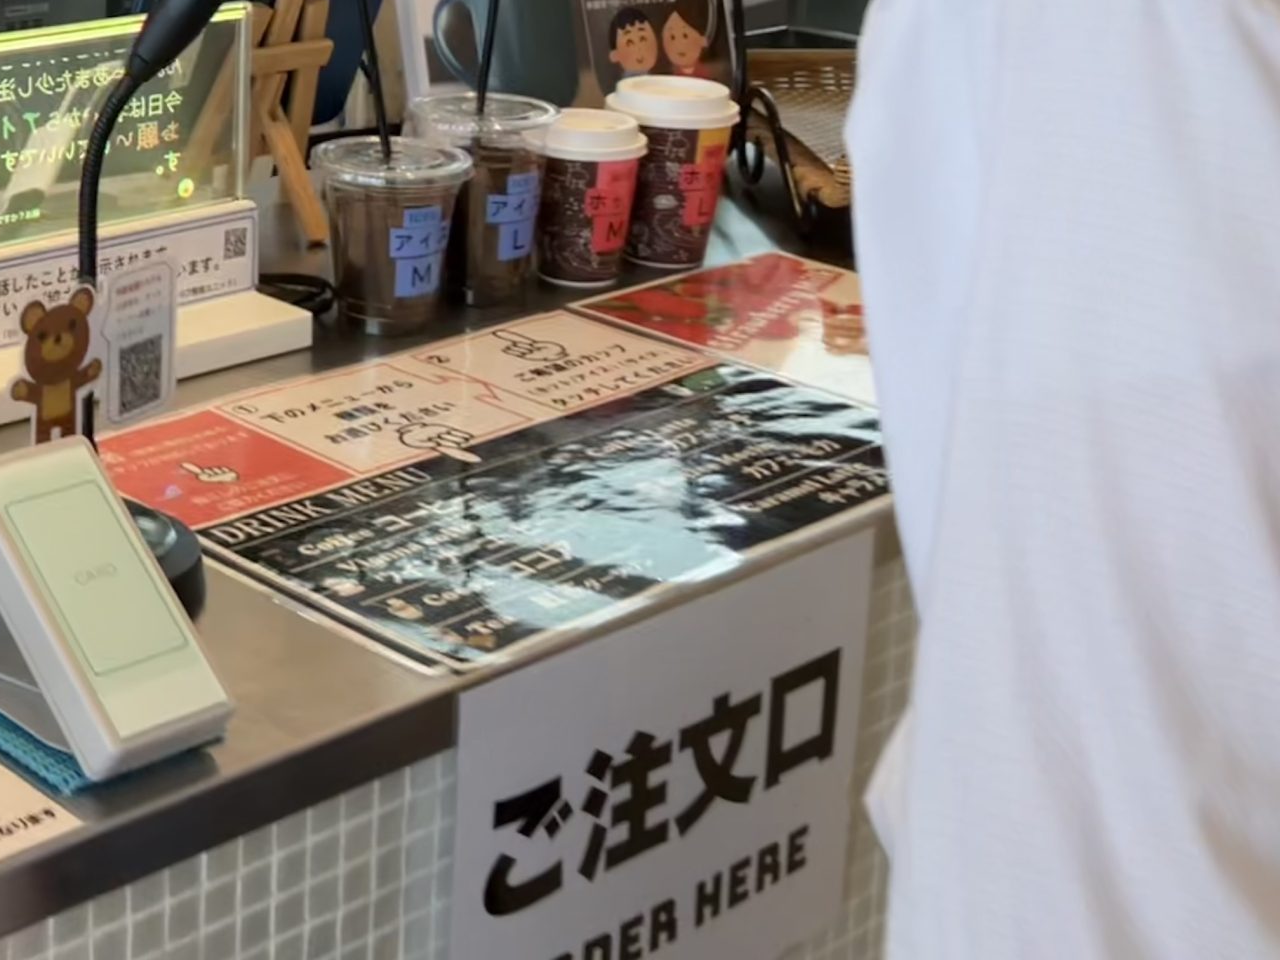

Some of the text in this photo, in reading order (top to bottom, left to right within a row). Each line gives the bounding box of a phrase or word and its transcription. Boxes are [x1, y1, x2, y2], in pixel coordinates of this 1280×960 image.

[512, 229, 525, 250] L
[411, 263, 431, 288] M
[258, 379, 414, 424] 下のメニューから
[210, 497, 334, 545] DRINK
[328, 467, 432, 508] MENU
[483, 647, 842, 918] ご注文口
[695, 824, 810, 929] HERE
